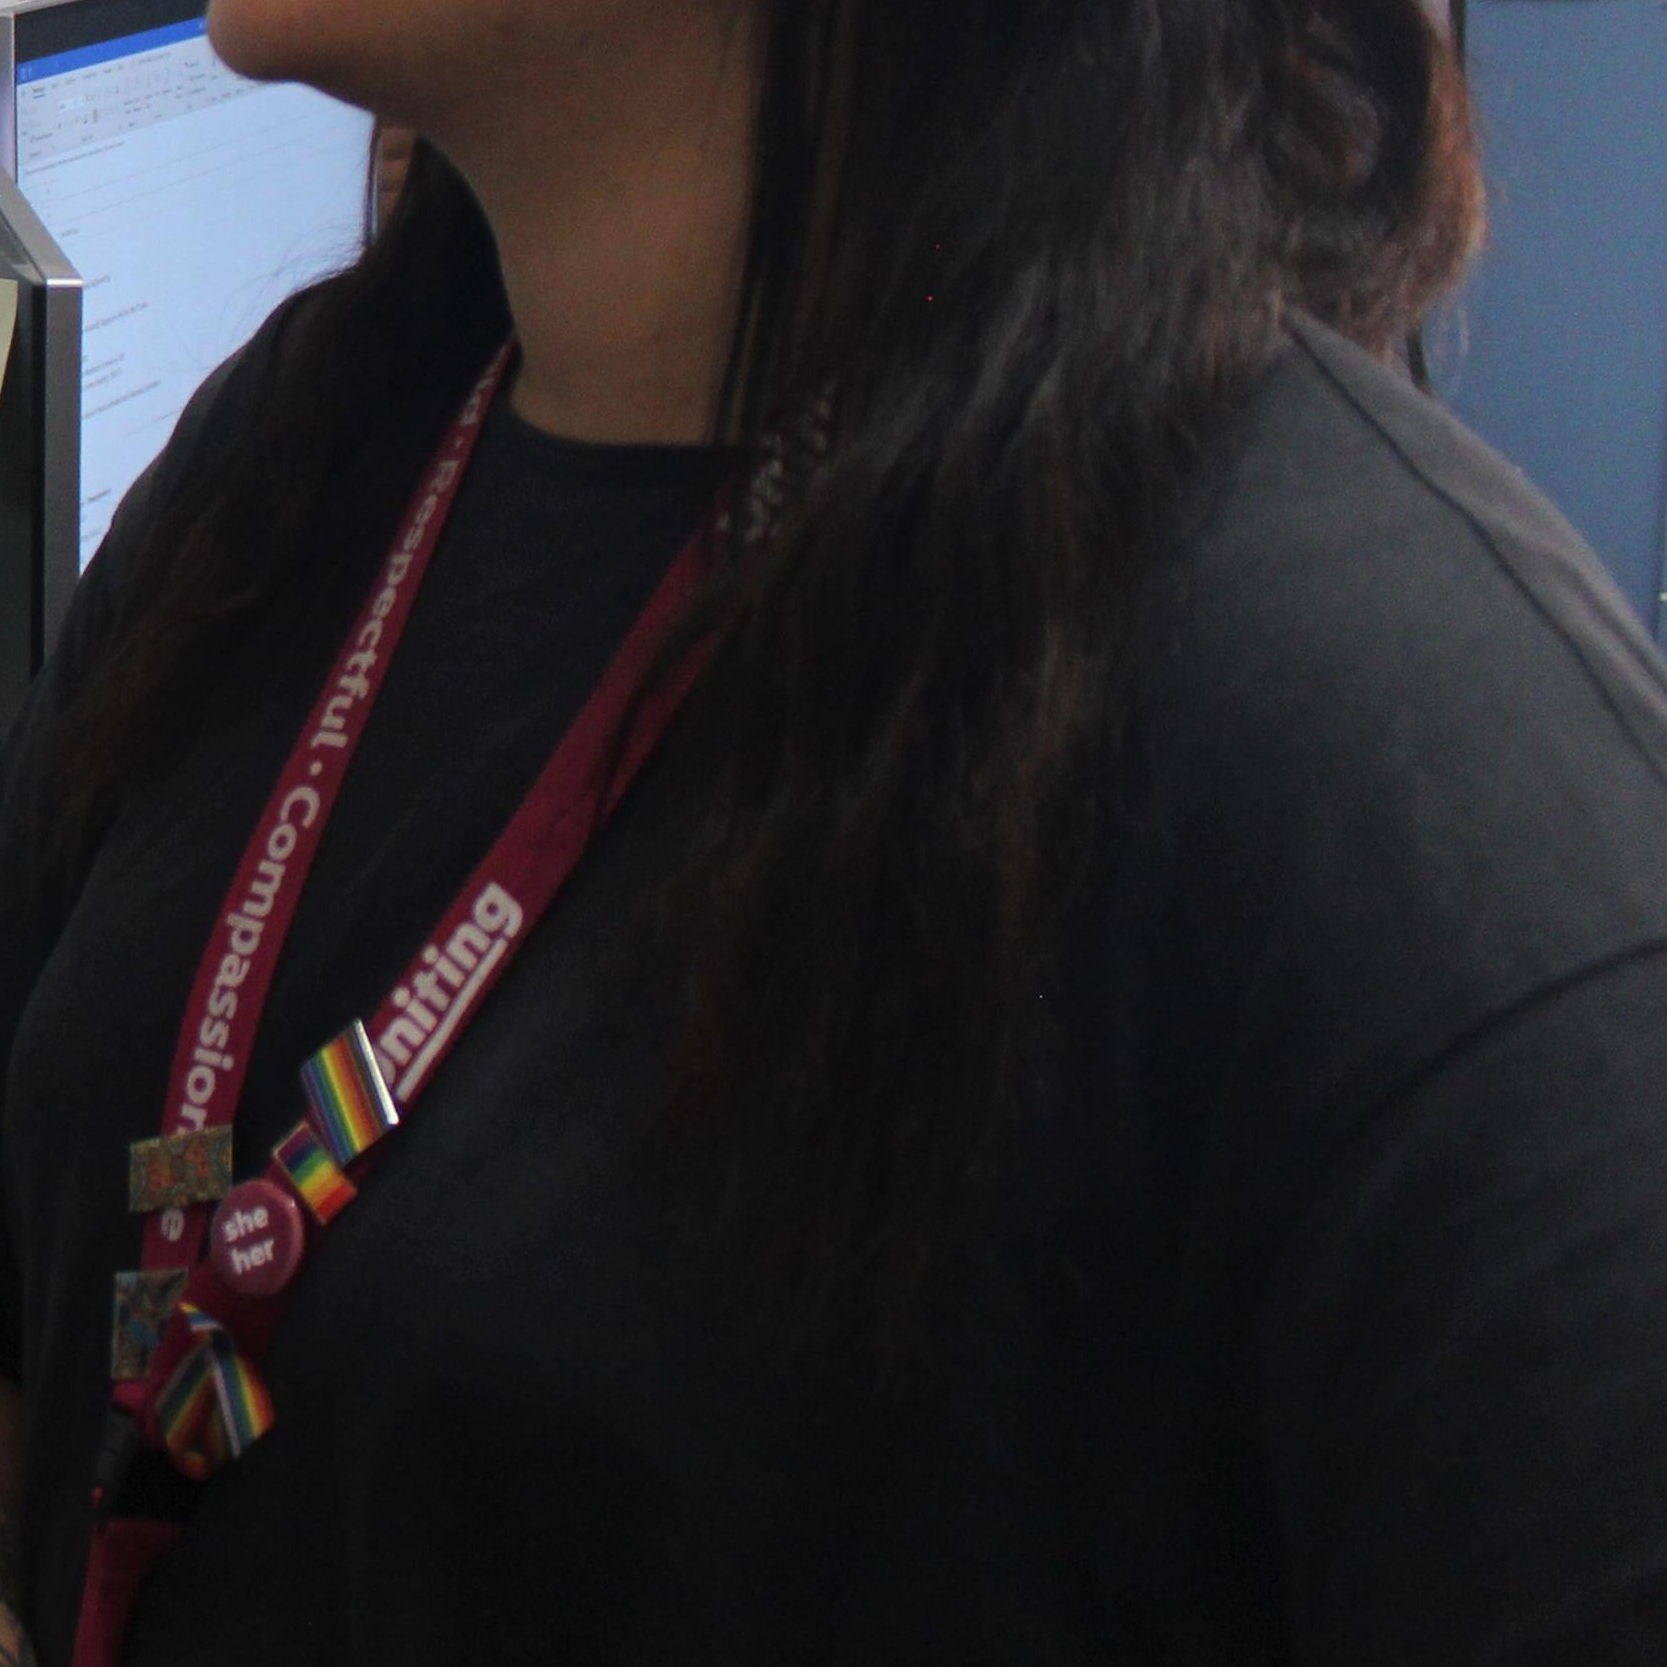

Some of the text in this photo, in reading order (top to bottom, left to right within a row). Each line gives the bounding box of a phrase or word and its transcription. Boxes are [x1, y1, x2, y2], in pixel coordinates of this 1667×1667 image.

[310, 460, 461, 749] Respectful
[377, 881, 524, 1086] niting
[222, 1206, 269, 1243] she
[230, 1237, 275, 1276] her
